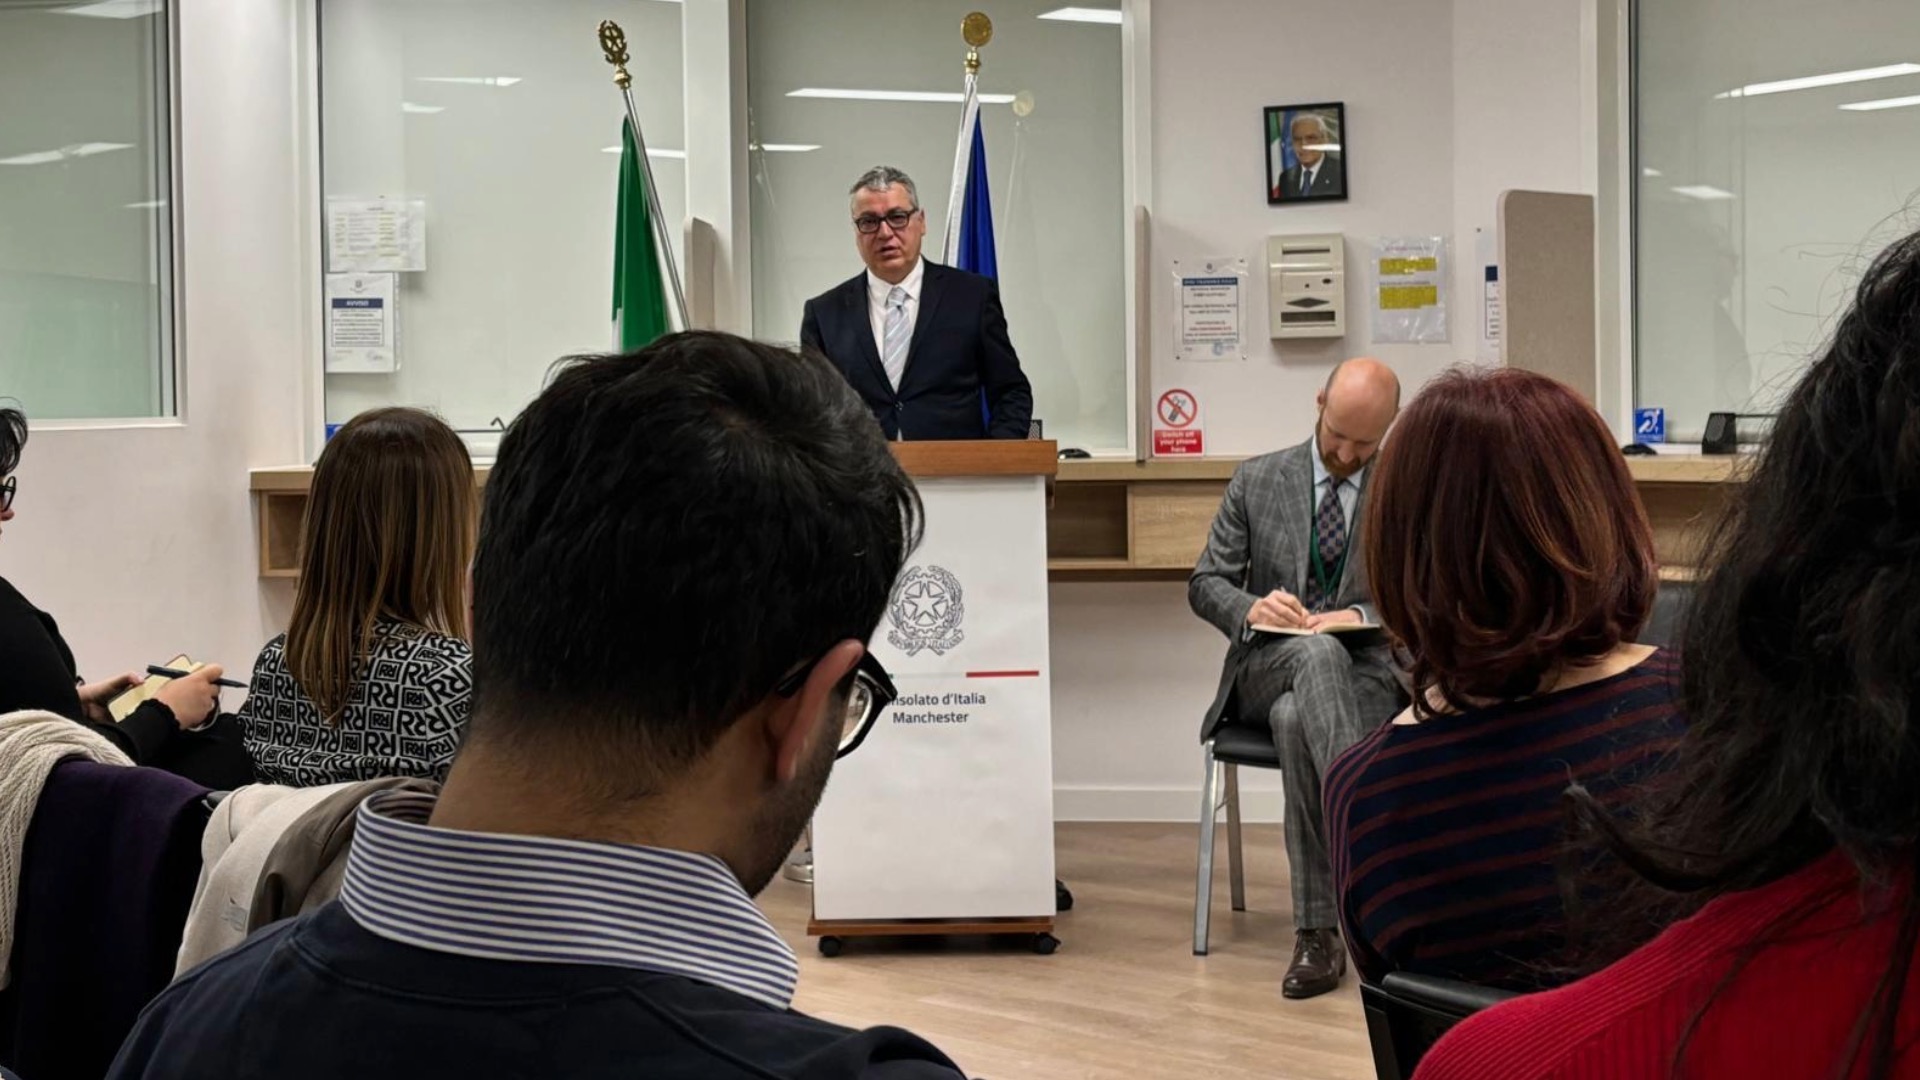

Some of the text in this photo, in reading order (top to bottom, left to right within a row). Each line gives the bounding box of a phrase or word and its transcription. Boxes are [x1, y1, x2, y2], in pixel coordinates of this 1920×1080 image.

[887, 692, 986, 706] nsolato d'Italia
[892, 711, 969, 724] Manchester
